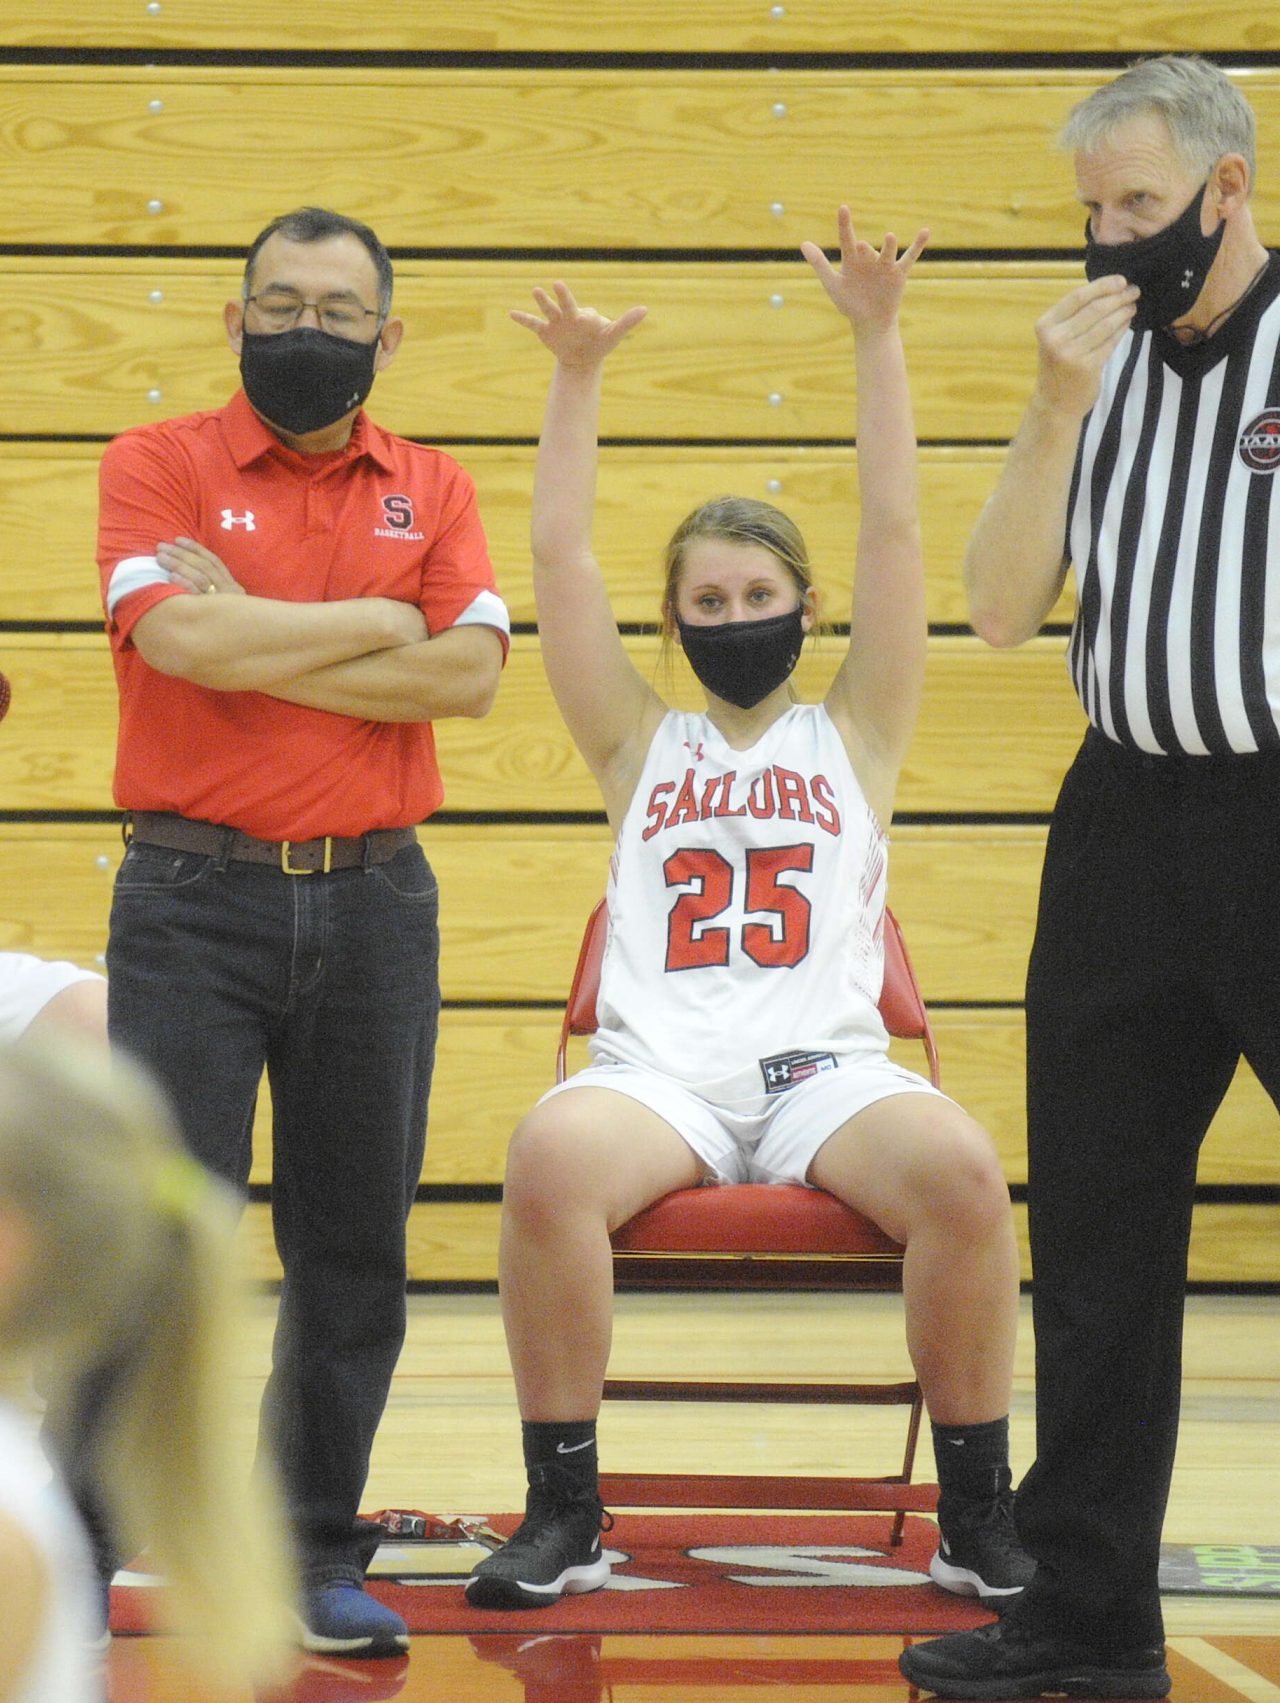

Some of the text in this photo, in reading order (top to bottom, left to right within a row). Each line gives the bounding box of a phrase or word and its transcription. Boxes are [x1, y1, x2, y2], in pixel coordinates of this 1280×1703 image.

[374, 527, 425, 541] BASKETBALL
[381, 494, 413, 531] S
[642, 765, 841, 842] SAILORS
[663, 843, 815, 973] 25
